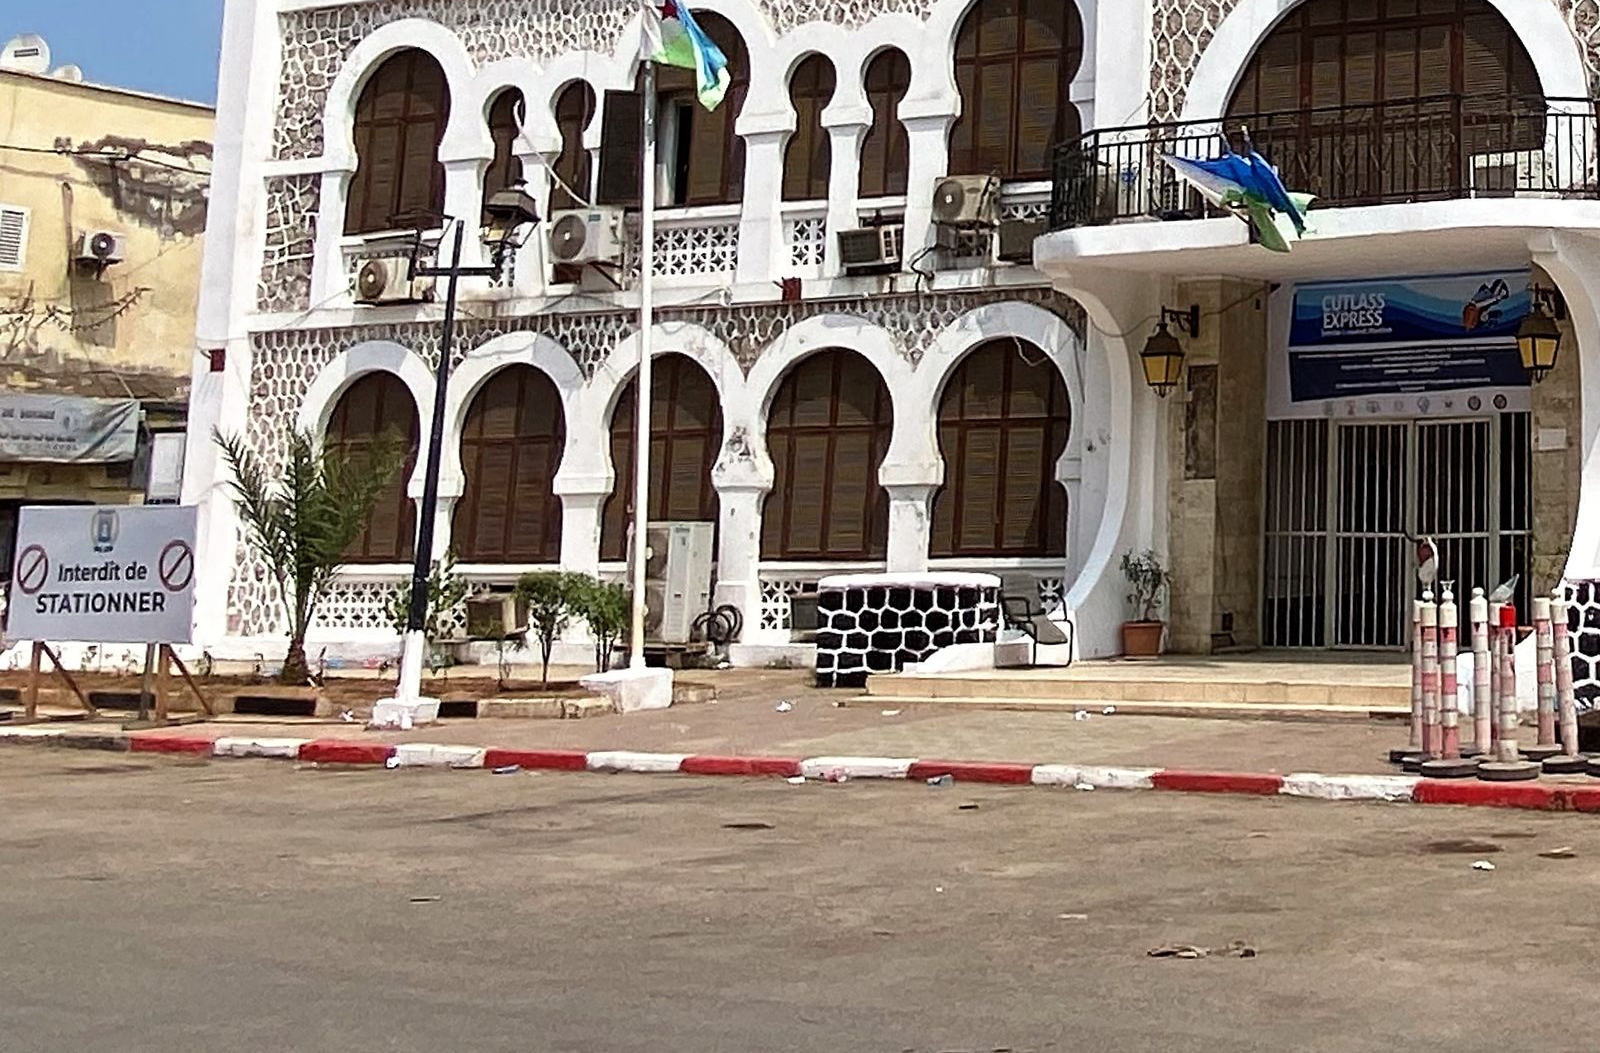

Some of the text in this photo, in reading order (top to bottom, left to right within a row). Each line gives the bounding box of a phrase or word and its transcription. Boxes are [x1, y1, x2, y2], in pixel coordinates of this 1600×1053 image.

[1322, 292, 1386, 311] CUTLASS
[1323, 310, 1383, 329] EXPRESS
[57, 561, 148, 582] Interdit de
[36, 591, 166, 614] STATIONNER
